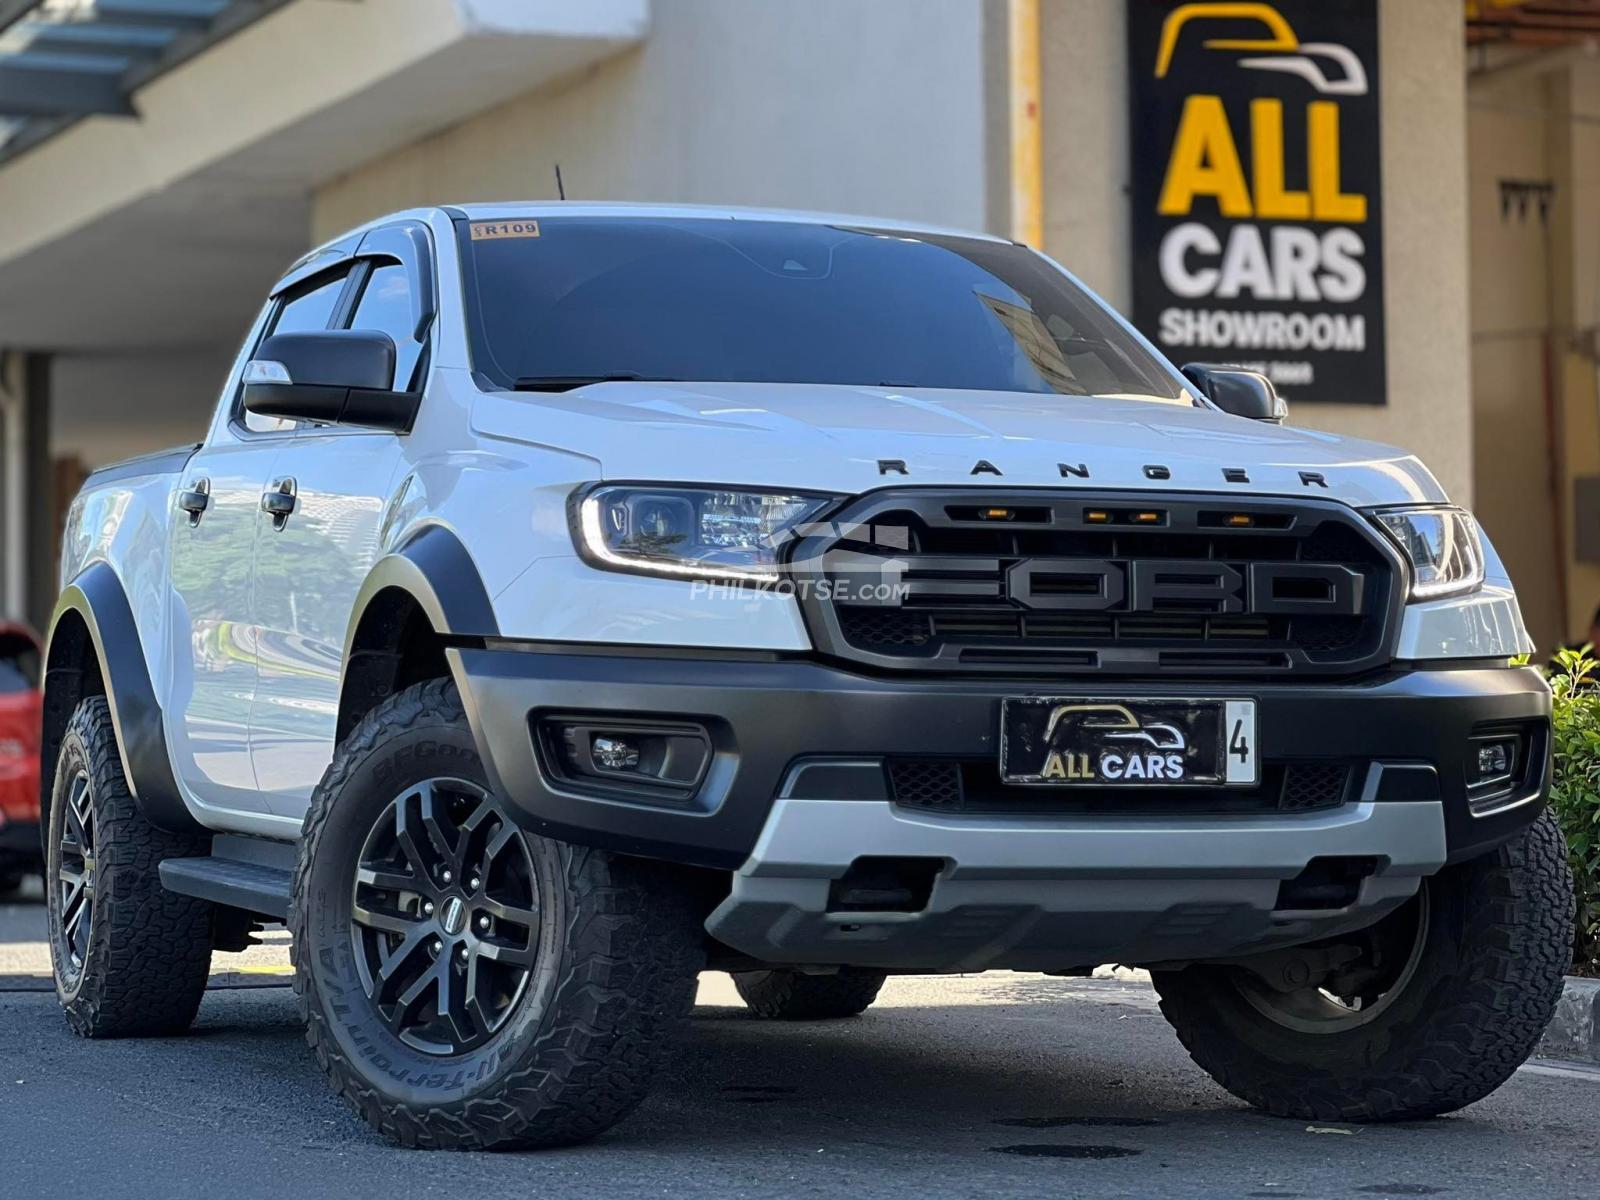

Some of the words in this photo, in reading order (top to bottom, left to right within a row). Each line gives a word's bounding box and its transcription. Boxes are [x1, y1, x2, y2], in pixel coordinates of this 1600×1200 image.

[1157, 94, 1367, 222] ALL
[485, 223, 537, 236] R109
[1158, 222, 1367, 302] CARS
[1158, 307, 1366, 351] SHOWROOM
[876, 458, 1329, 489] RANGER
[833, 554, 1365, 615] FORD
[1228, 718, 1250, 764] 4
[1043, 753, 1096, 779] ALL
[1101, 754, 1184, 780] CARS
